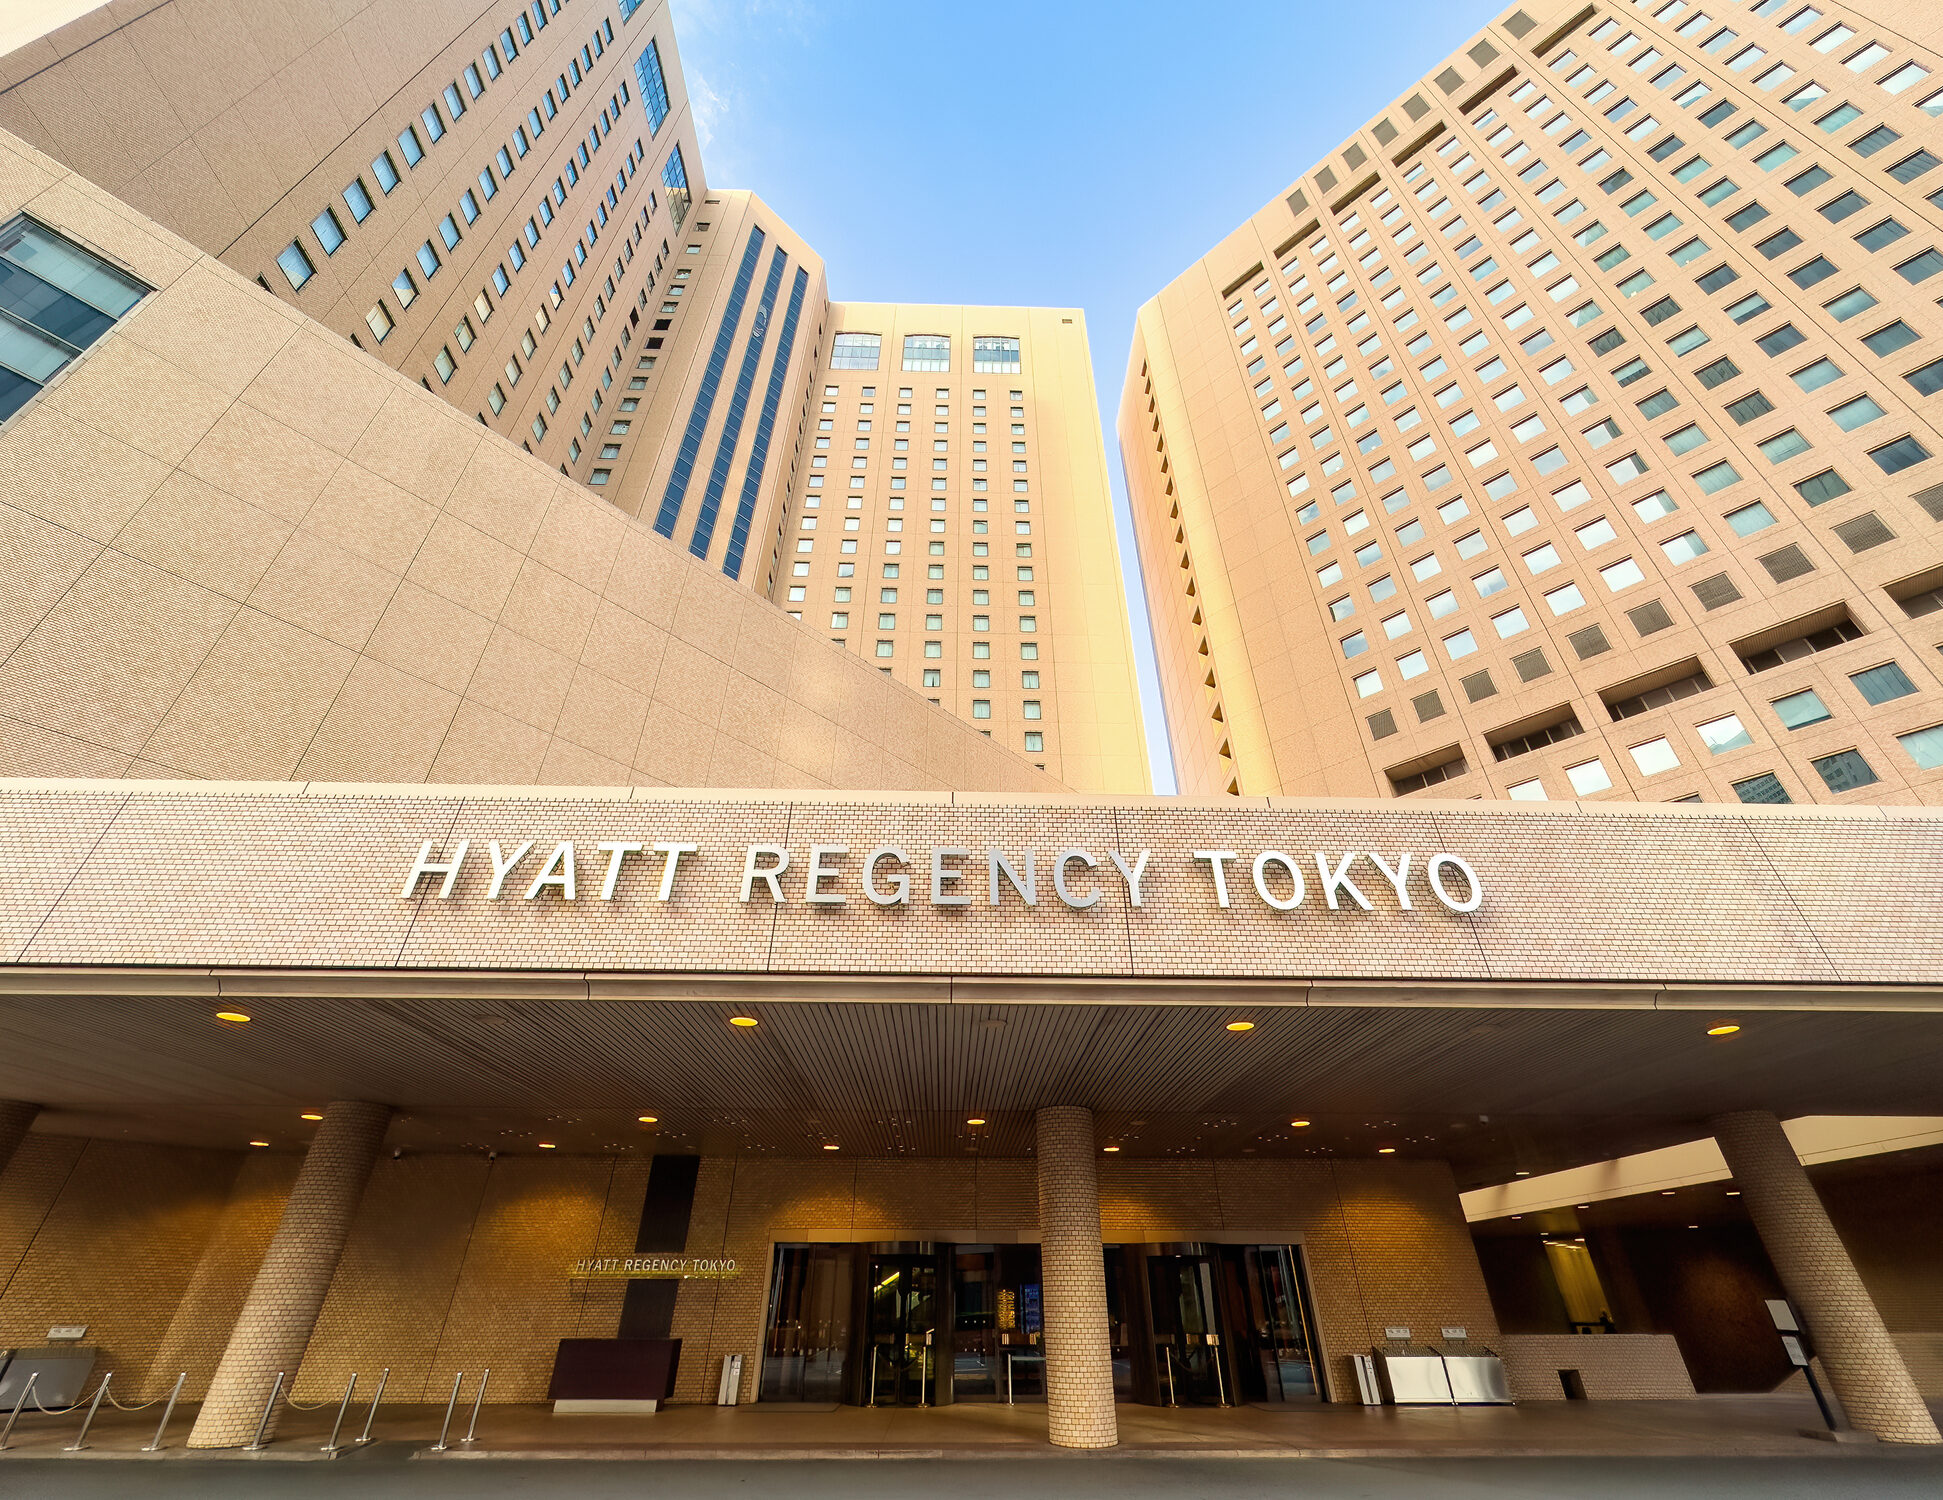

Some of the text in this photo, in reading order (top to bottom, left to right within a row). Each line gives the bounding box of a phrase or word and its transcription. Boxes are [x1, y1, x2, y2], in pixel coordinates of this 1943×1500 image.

[400, 840, 1484, 914] HYATT REGENCY TOKYO
[576, 1259, 736, 1272] HYATT REGENCY TOKYO
